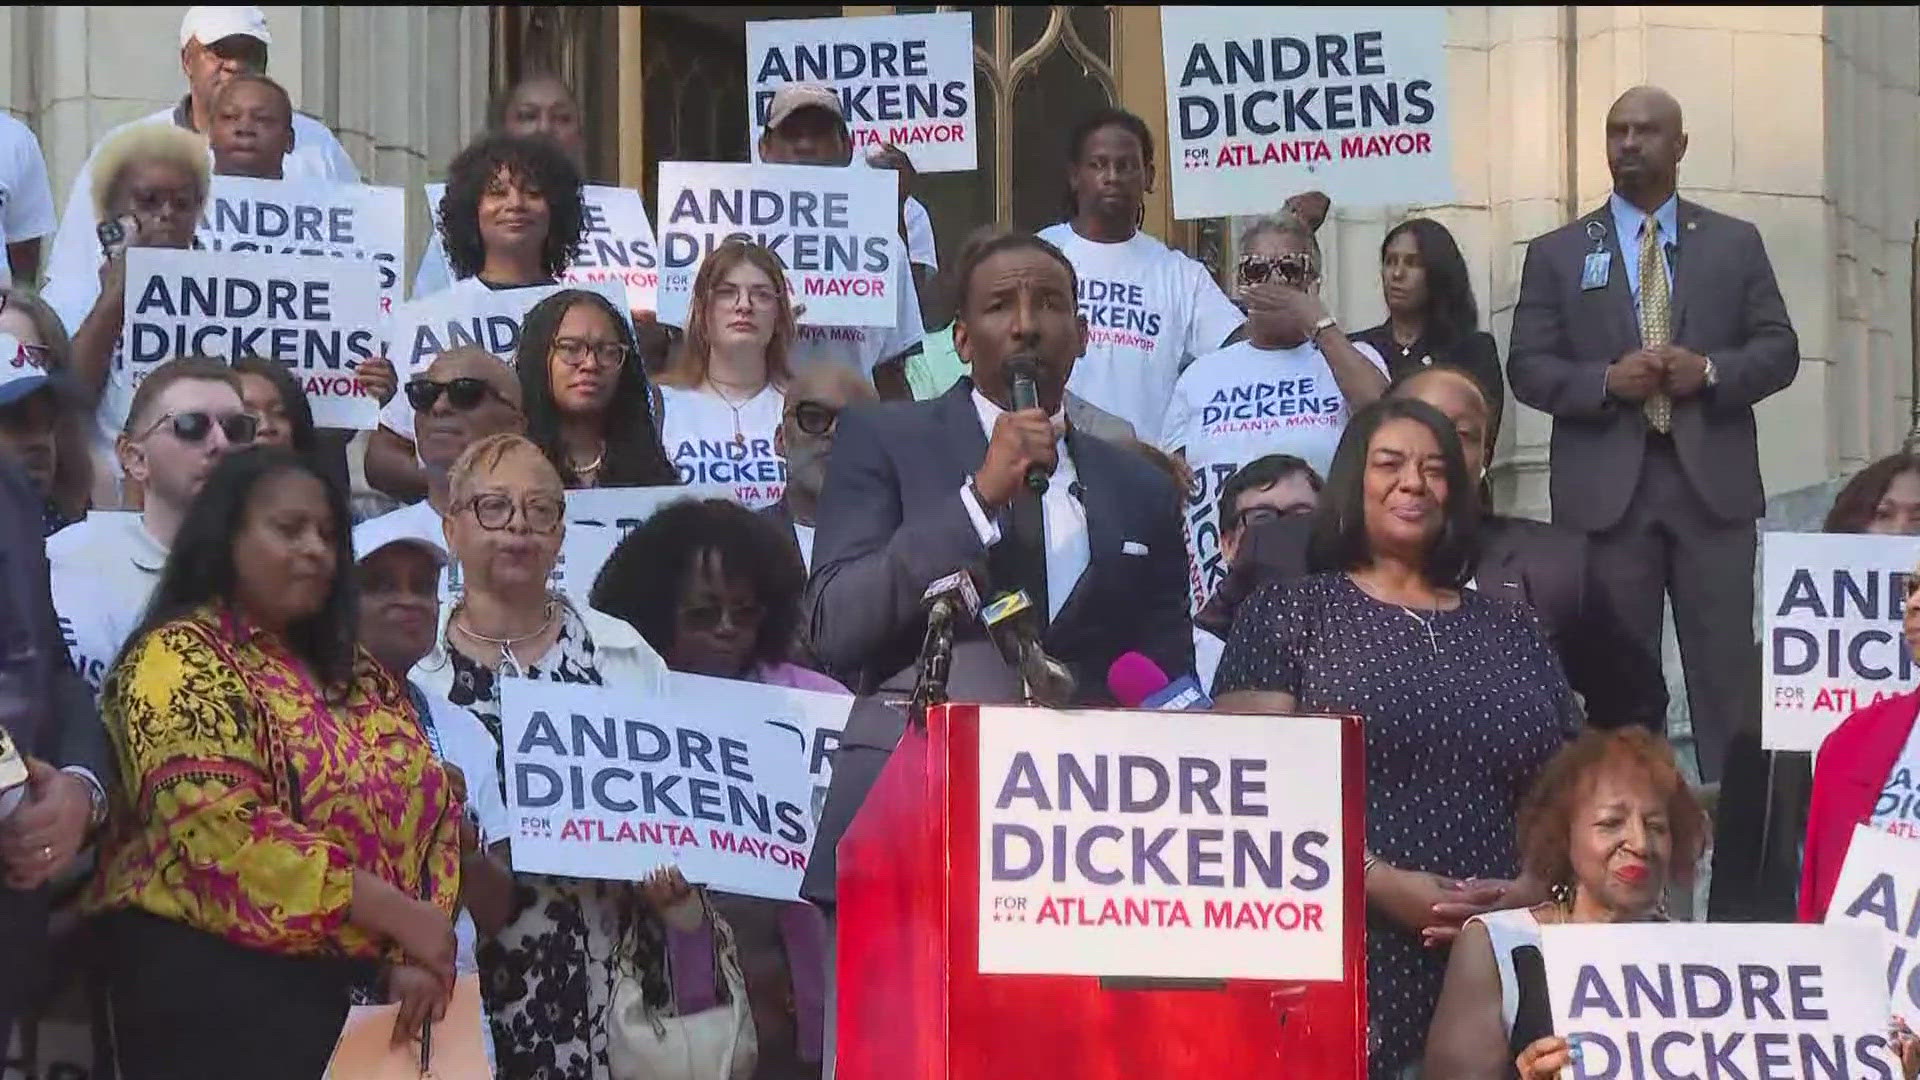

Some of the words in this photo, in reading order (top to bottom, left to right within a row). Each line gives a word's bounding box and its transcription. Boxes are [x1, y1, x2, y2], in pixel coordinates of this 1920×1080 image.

[756, 40, 928, 83] ANDRE
[1180, 31, 1386, 87] ANDRE
[1178, 79, 1435, 140] DICKENS
[890, 124, 964, 146] MAYOR
[1184, 147, 1209, 159] FOR
[1216, 139, 1332, 168] ATLANTA
[1341, 133, 1432, 159] MAYOR
[200, 198, 355, 244] NDRE
[669, 188, 849, 229] ANDRE
[135, 275, 331, 322] ANDRE
[666, 275, 688, 286] FOR
[804, 278, 885, 297] MAYOR
[1079, 279, 1144, 306] DRE
[409, 315, 519, 365] AND
[1079, 303, 1161, 336] KENS
[131, 323, 375, 371] DICKENS
[1114, 333, 1155, 352] MAYOR
[296, 375, 367, 397] AYOR
[1210, 377, 1314, 403] ANDRE
[1202, 396, 1340, 426] DICKENS
[1212, 418, 1280, 435] ATLANTA
[1286, 413, 1337, 428] MAYOR
[676, 439, 772, 461] ANDR
[675, 461, 786, 483] DICKE
[1775, 687, 1804, 699] FOR
[517, 711, 753, 782] ANDRE
[515, 763, 808, 844] DICKENS
[994, 751, 1269, 817] ANDRE
[521, 817, 550, 829] FOR
[560, 818, 700, 848] ATLANTA
[709, 829, 807, 872] MAYOR
[991, 823, 1331, 891] DICKENS
[994, 896, 1027, 909] FOR
[1036, 896, 1192, 928] ATLANTA
[1204, 899, 1324, 932] MAYOR
[1568, 963, 1829, 1020] ANDRE
[1568, 1031, 1894, 1080] DICKENS
